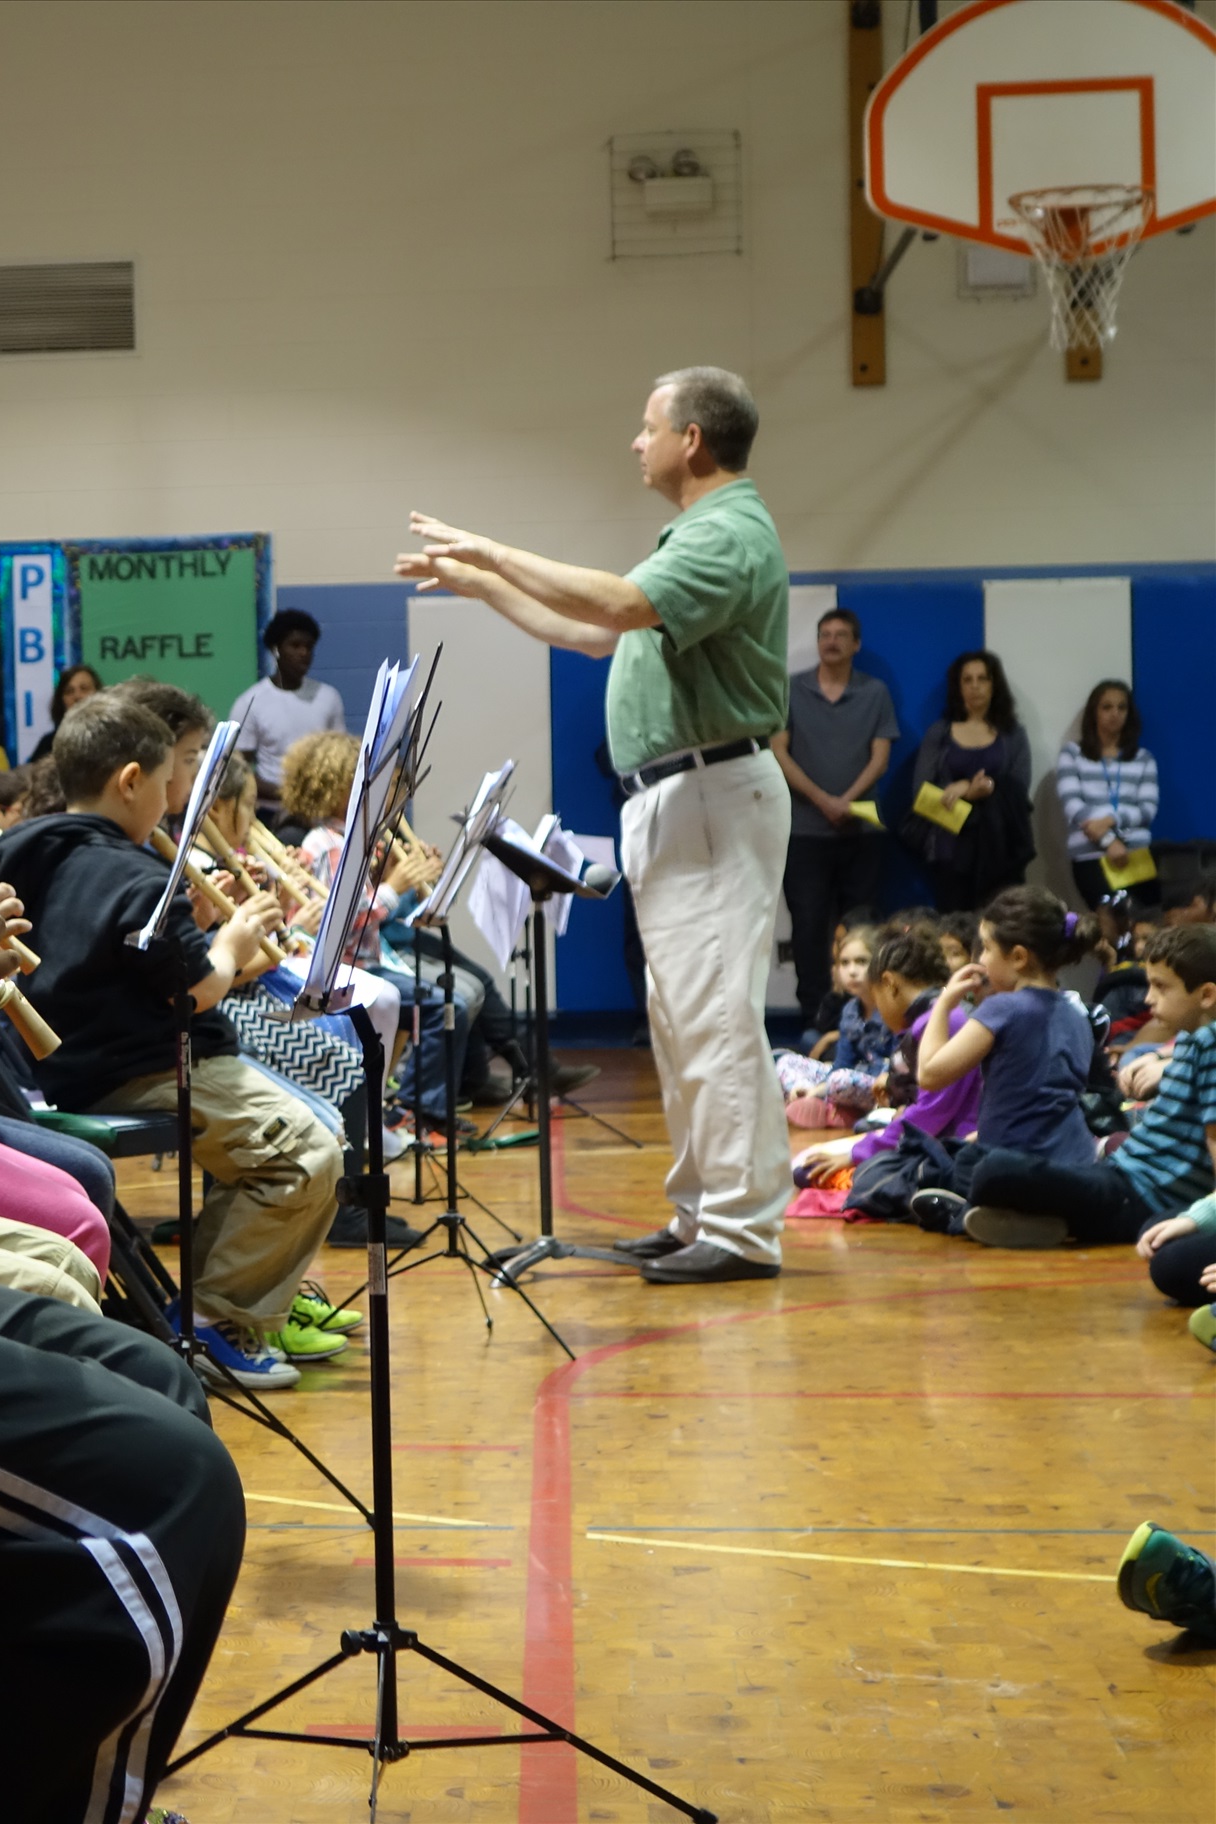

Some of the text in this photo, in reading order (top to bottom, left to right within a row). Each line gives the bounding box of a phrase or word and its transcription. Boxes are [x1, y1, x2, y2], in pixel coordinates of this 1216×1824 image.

[87, 551, 232, 582] MONTHLY
[100, 632, 214, 660] RAFFLE
[19, 564, 46, 760] PBI
